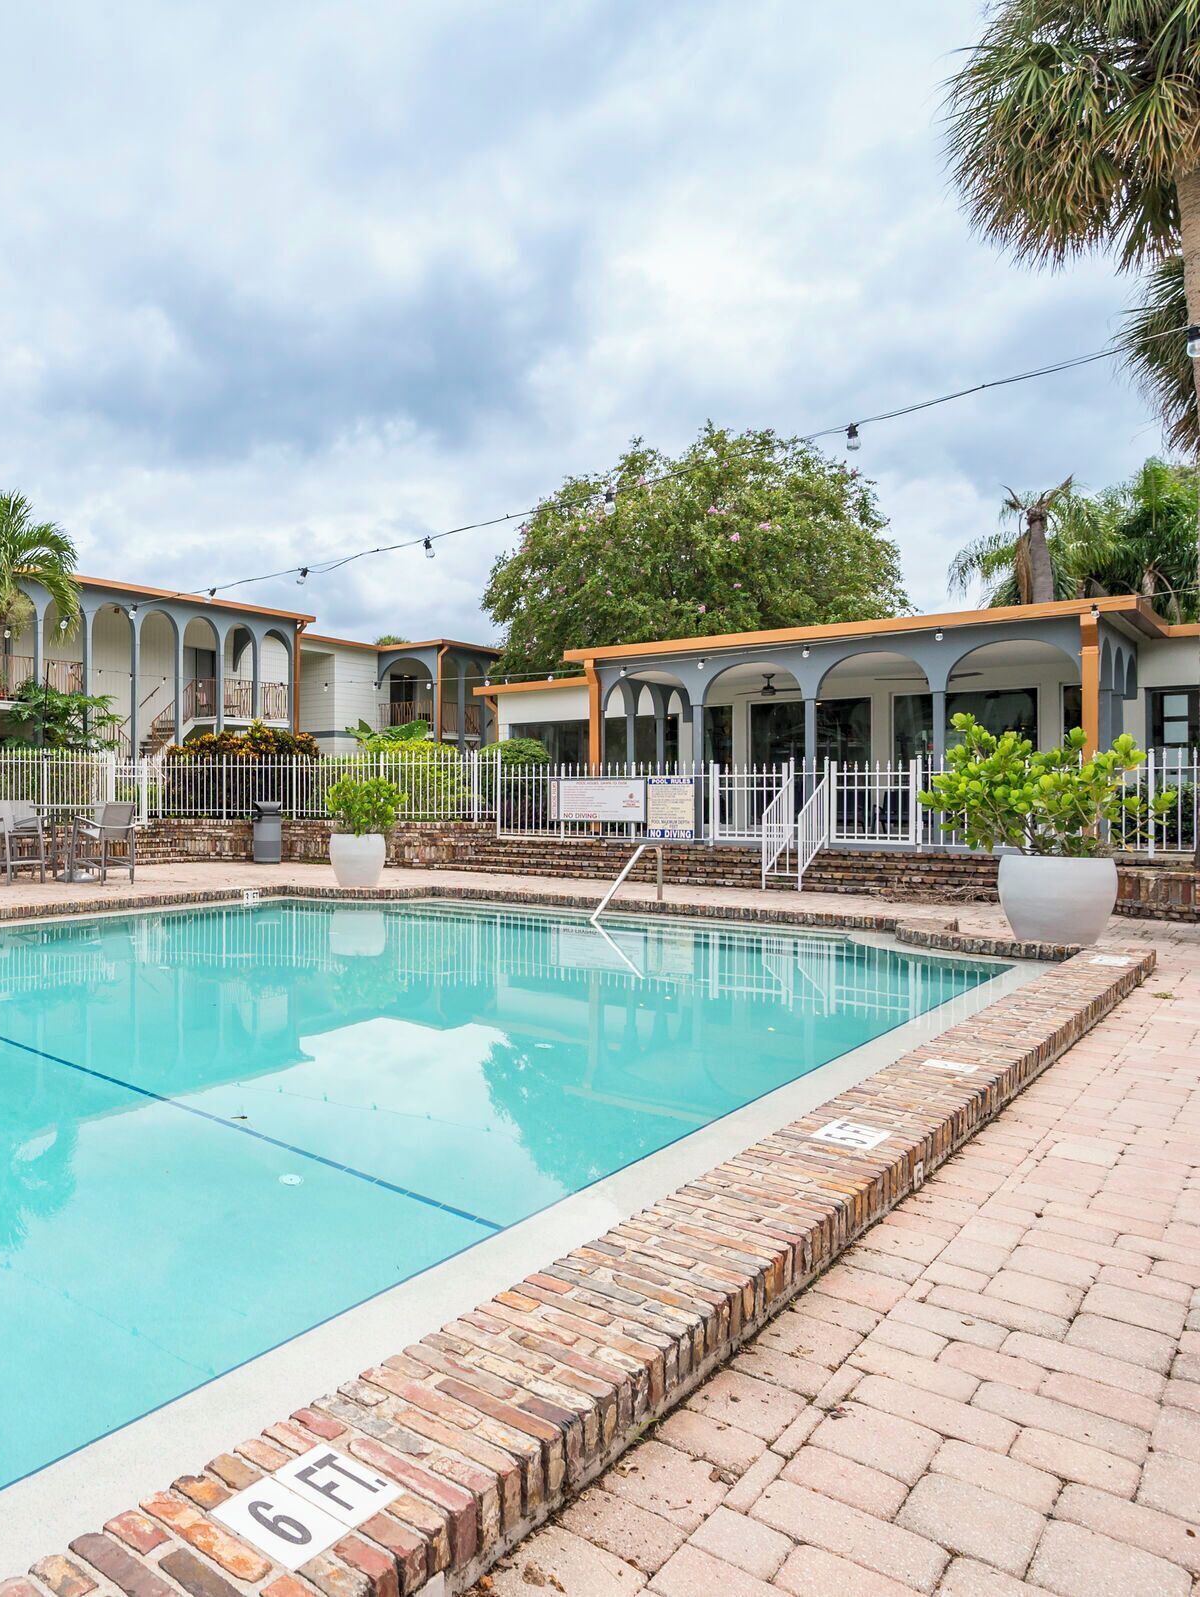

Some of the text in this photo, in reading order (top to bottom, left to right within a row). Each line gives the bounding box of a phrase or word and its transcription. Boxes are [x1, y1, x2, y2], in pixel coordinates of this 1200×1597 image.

[650, 829, 692, 838] NO DIVING
[824, 1133, 868, 1145] 5
[247, 1500, 313, 1545] 6
